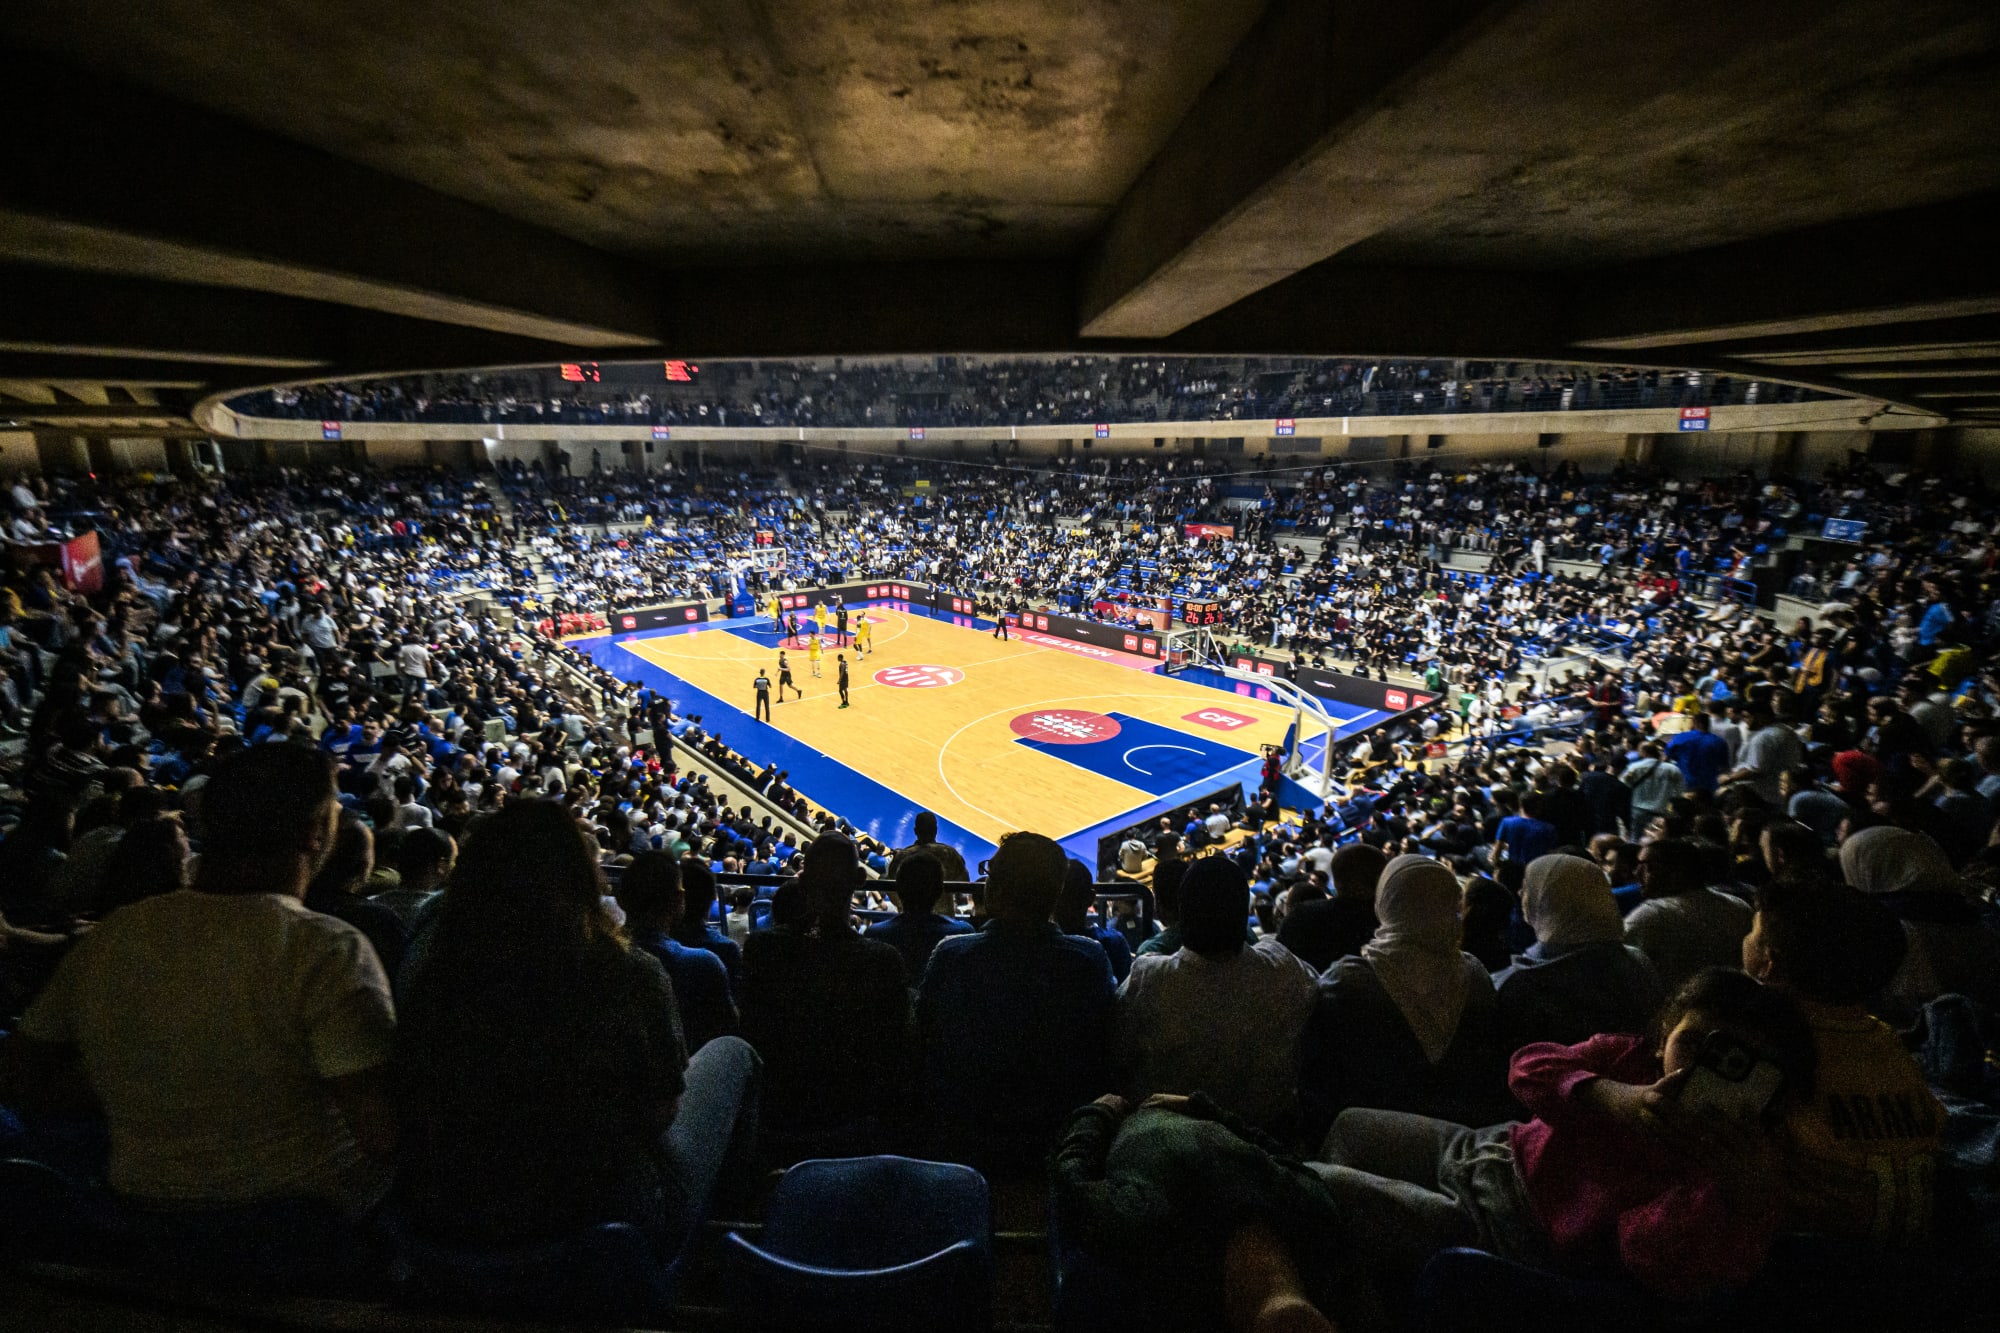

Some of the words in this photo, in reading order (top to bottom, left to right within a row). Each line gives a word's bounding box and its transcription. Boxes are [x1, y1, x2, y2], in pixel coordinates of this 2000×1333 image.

[1185, 611, 1199, 624] 26
[1204, 612, 1215, 625] 26
[1026, 635, 1115, 657] LEBANON
[1198, 712, 1244, 727] CFI
